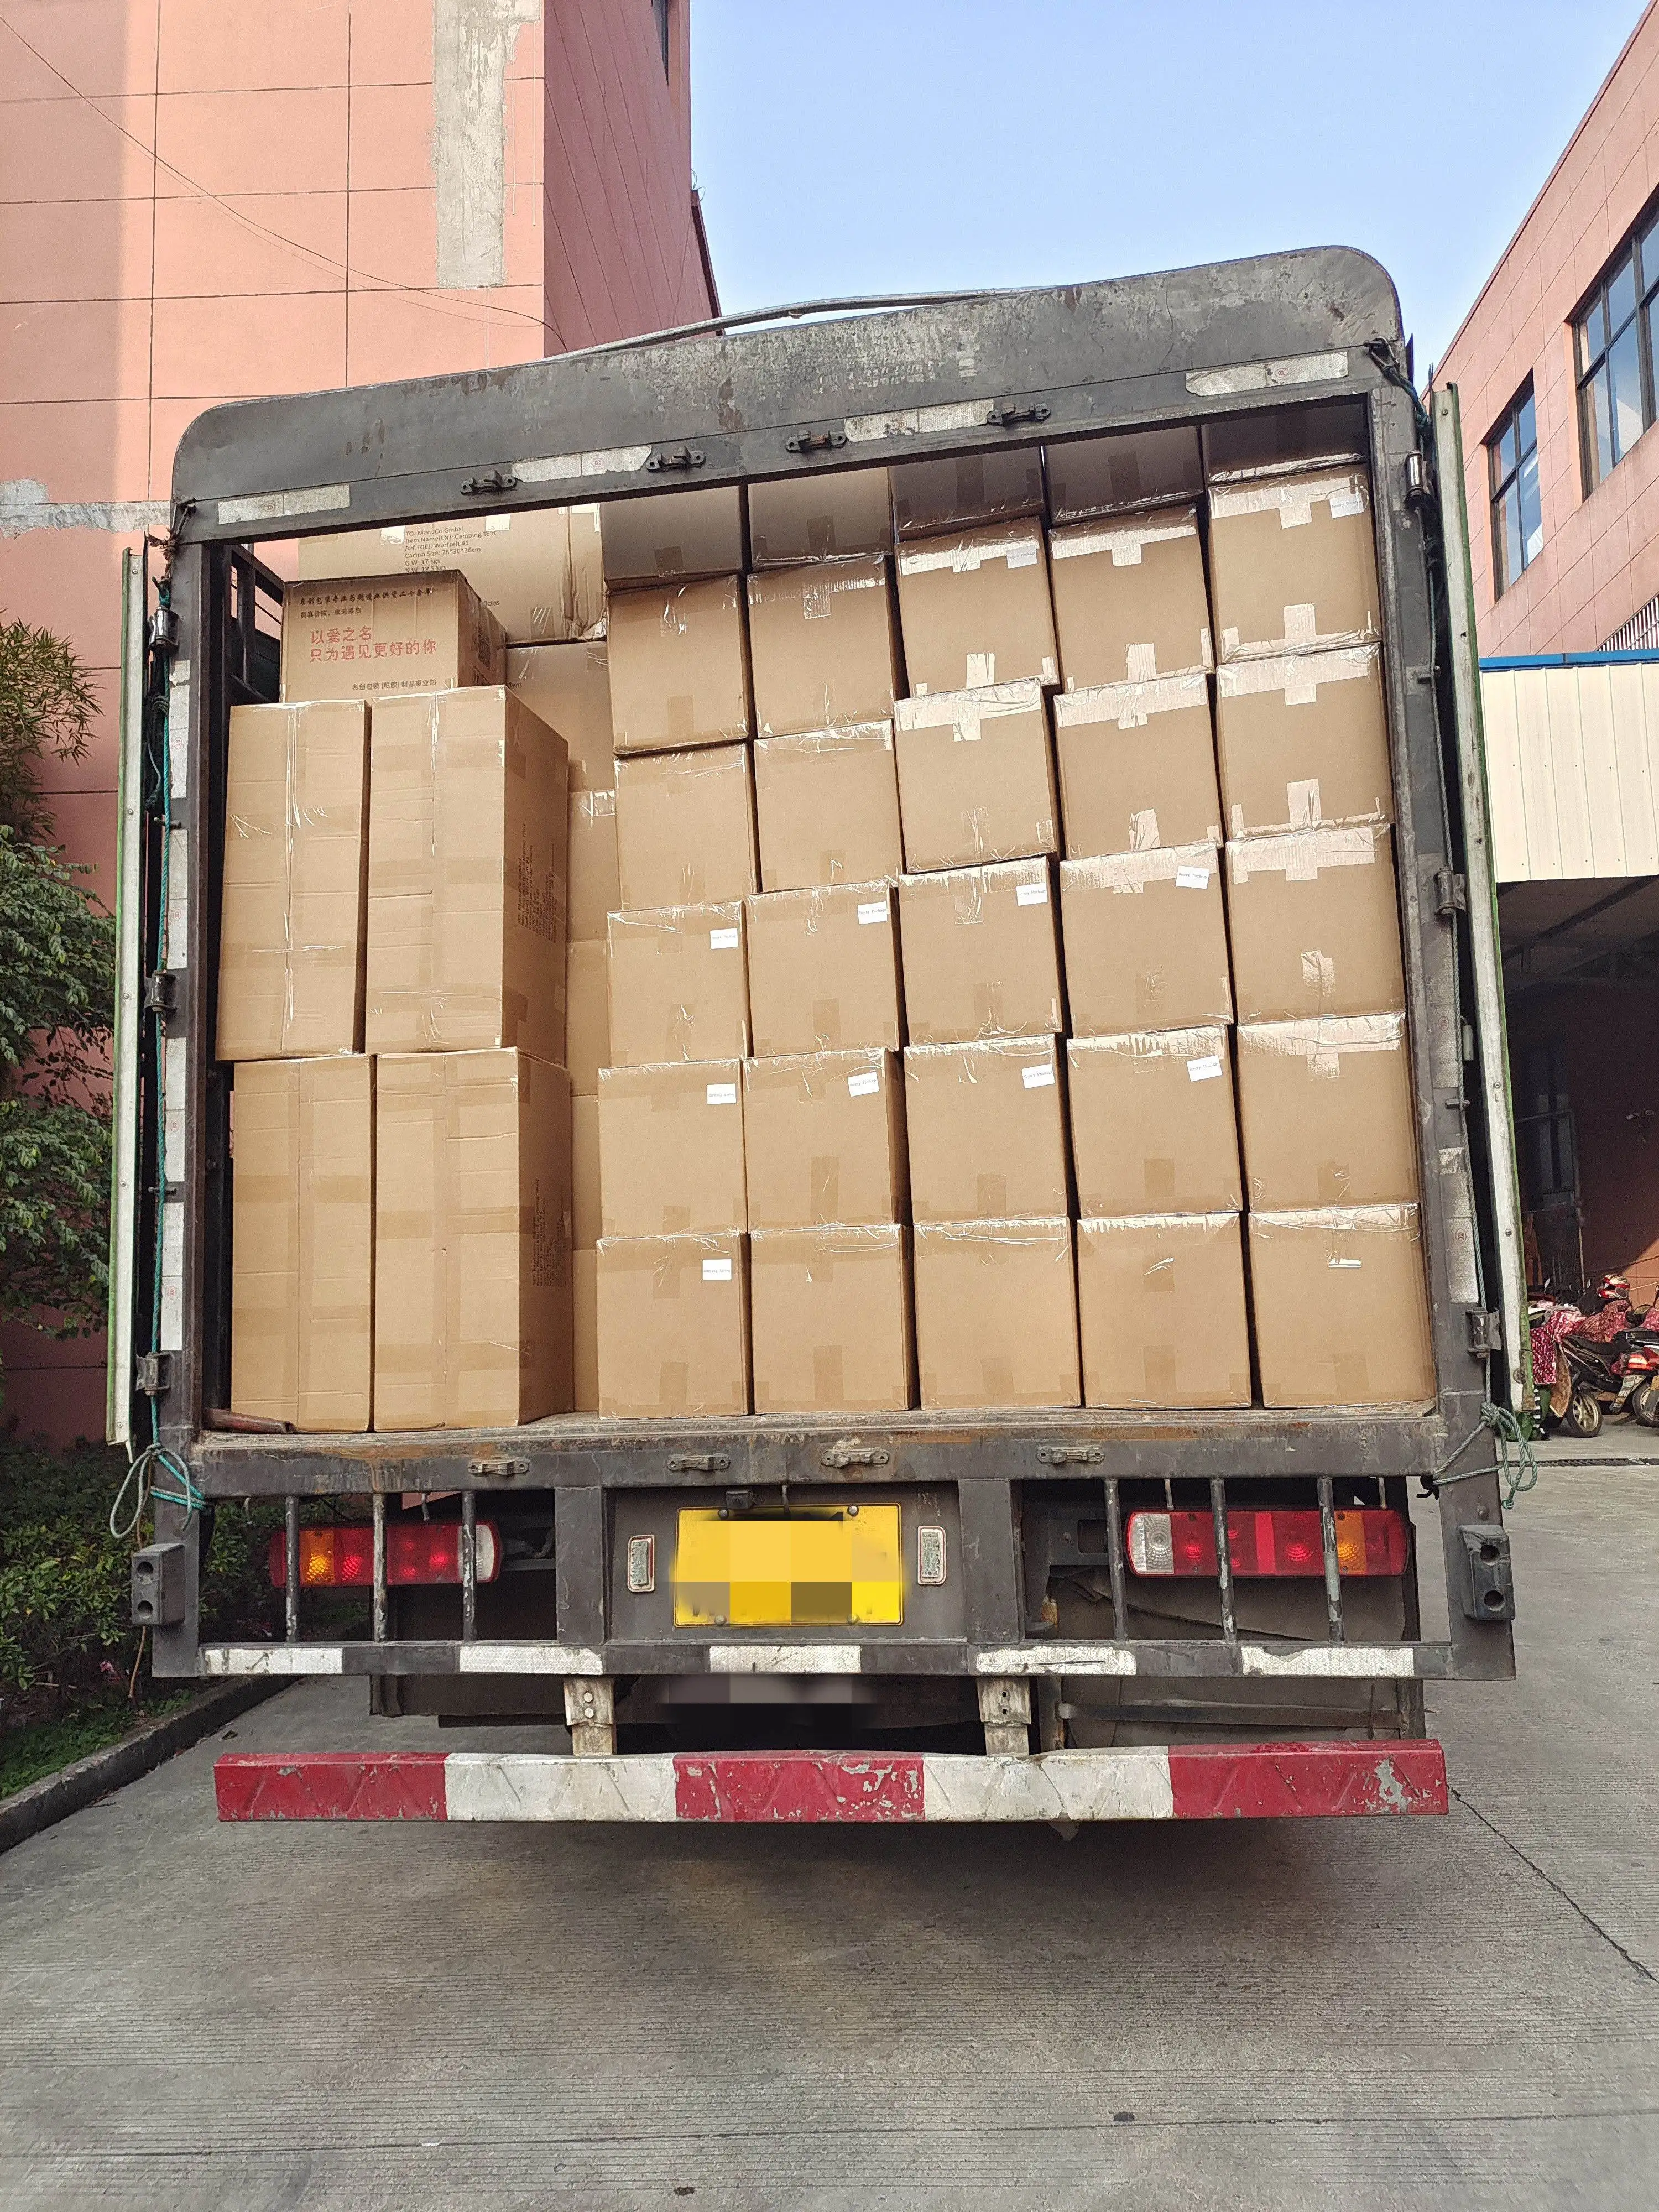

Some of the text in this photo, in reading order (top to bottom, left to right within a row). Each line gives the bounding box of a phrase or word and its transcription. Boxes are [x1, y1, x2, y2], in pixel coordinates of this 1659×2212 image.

[311, 625, 372, 644] 以爱之名
[309, 638, 437, 663] 只为遇见更好的你
